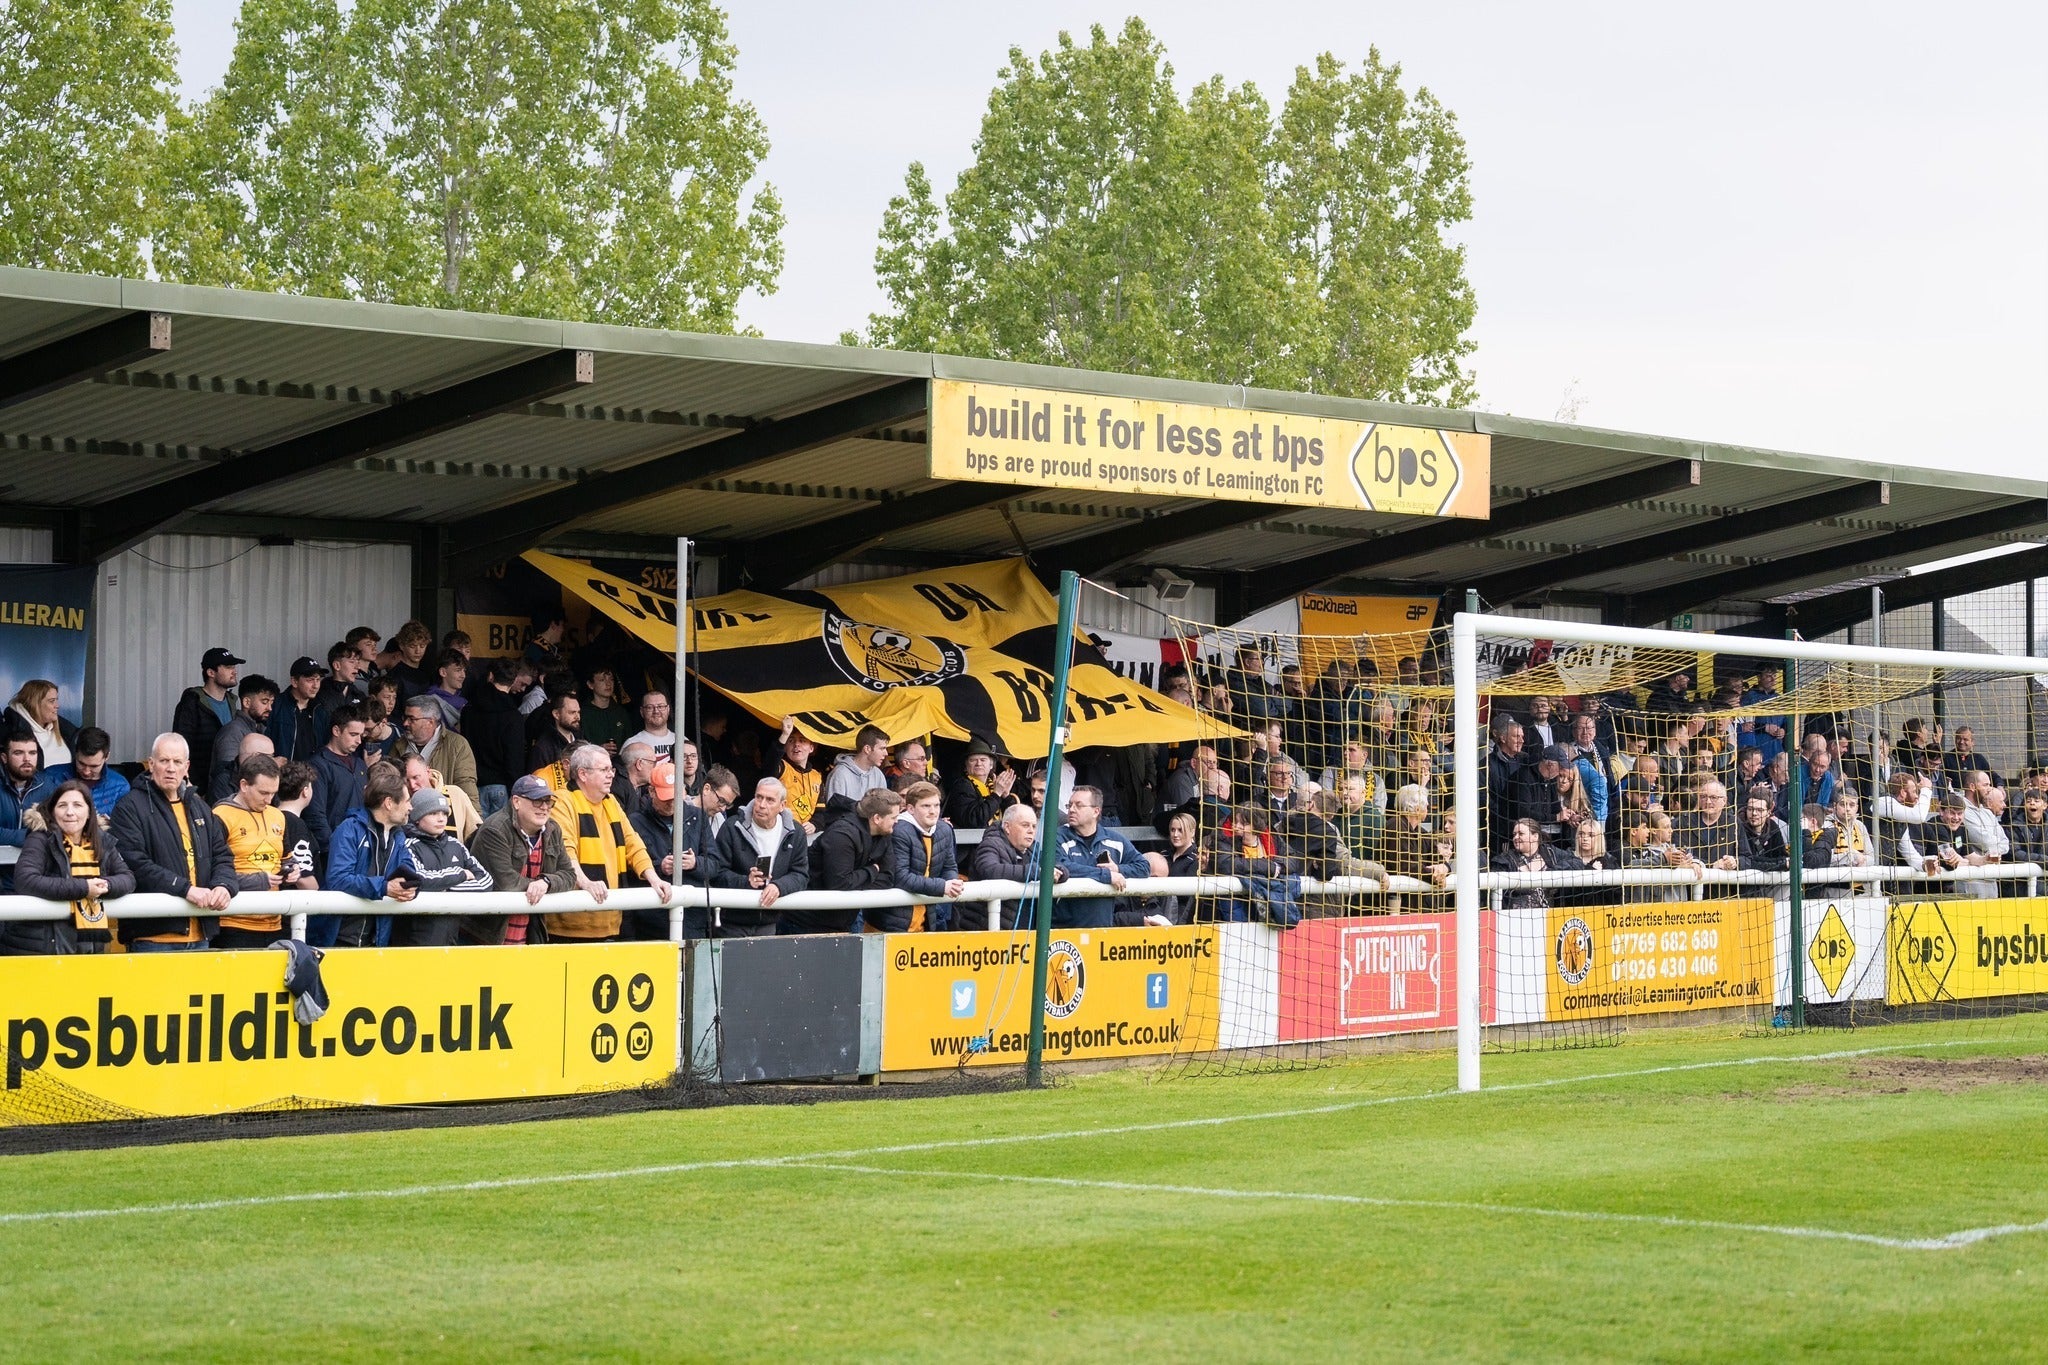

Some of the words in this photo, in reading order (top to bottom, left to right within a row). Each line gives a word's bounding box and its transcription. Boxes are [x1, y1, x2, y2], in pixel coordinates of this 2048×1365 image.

[968, 395, 1051, 442] build
[1064, 404, 1086, 446] it
[1097, 408, 1145, 450] for
[1156, 414, 1222, 457] less
[1232, 423, 1263, 461] at
[1273, 425, 1324, 472] bps
[966, 448, 998, 473] bps
[1005, 456, 1034, 474] are
[1041, 458, 1092, 478] proud
[1099, 463, 1177, 484] sponsors
[1183, 466, 1200, 485] of
[1207, 468, 1299, 496] Leamington
[1305, 476, 1323, 495] FC
[1374, 432, 1438, 497] bps
[0, 601, 85, 631] LLERAN
[1303, 594, 1358, 615] Lockheed
[1606, 914, 1617, 928] To
[1620, 911, 1663, 927] advertise
[1664, 910, 1685, 926] here
[1687, 910, 1722, 924] contact:
[1100, 938, 1212, 965] LeamingtonFC
[1355, 934, 1427, 975] PITCHING
[1611, 932, 1656, 955] 07769
[1660, 930, 1688, 952] 682
[1691, 928, 1718, 950] 680
[1819, 934, 1847, 965] bps
[1908, 929, 1944, 972] bps
[895, 944, 1030, 971] @LeamingtonFC
[1660, 956, 1686, 978] 430
[1691, 953, 1717, 976] 406
[1389, 973, 1406, 1011] IN
[6, 986, 514, 1090] psbuildit.co.uk
